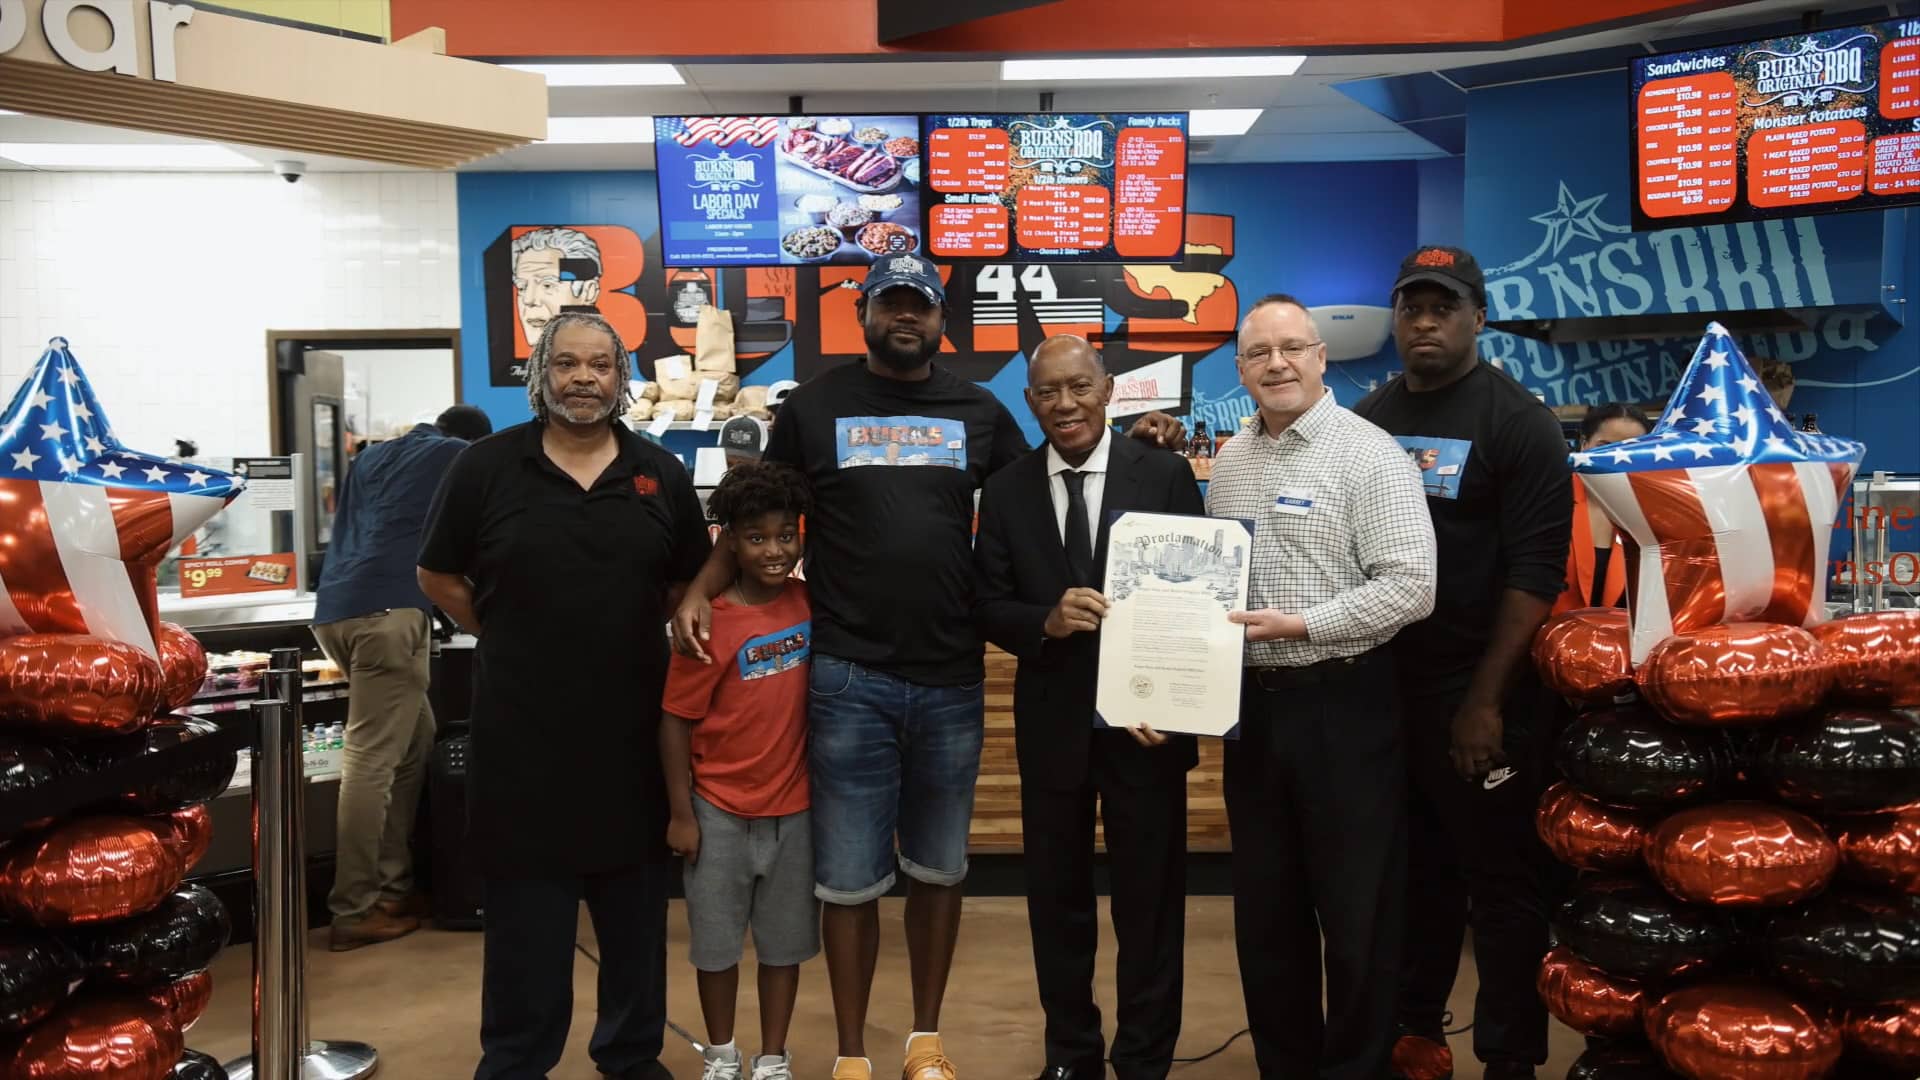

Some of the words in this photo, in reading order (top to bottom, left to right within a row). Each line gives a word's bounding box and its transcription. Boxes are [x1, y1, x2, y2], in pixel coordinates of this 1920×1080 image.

[0, 0, 195, 82] ar
[1893, 54, 1915, 63] LINKS
[1647, 56, 1726, 76] Sandwiches
[1757, 52, 1823, 80] BURNS
[1823, 47, 1862, 85] BBQ
[1757, 73, 1823, 94] ORIGINAL
[970, 117, 992, 128] Trays
[1127, 117, 1155, 127] Family
[1157, 117, 1181, 126] Packs
[1754, 114, 1805, 130] Monster
[1809, 106, 1868, 123] Potatoes
[1020, 130, 1074, 148] BURNS
[1765, 134, 1785, 142] PLAIN
[1810, 128, 1836, 137] POTATO
[1074, 130, 1104, 160] BBQ
[1811, 146, 1838, 154] POTATO
[1020, 147, 1074, 159] ORIGINAL
[1875, 153, 1895, 161] DIRTY
[694, 160, 733, 172] BURNS
[1811, 163, 1838, 171] POTATO
[1875, 160, 1902, 168] POTATO
[1057, 176, 1088, 185] Dinners
[1811, 181, 1838, 189] POTATO
[693, 193, 732, 210] LABOR
[735, 193, 759, 208] DAY
[944, 194, 969, 203] Small
[971, 192, 999, 205] Family
[706, 208, 745, 219] SPECIALS
[1486, 237, 1653, 322] RNS
[847, 425, 944, 447] BURNS
[1832, 498, 1905, 530] ine
[1136, 532, 1223, 559] Proclamation
[1488, 766, 1511, 781] NIKE
